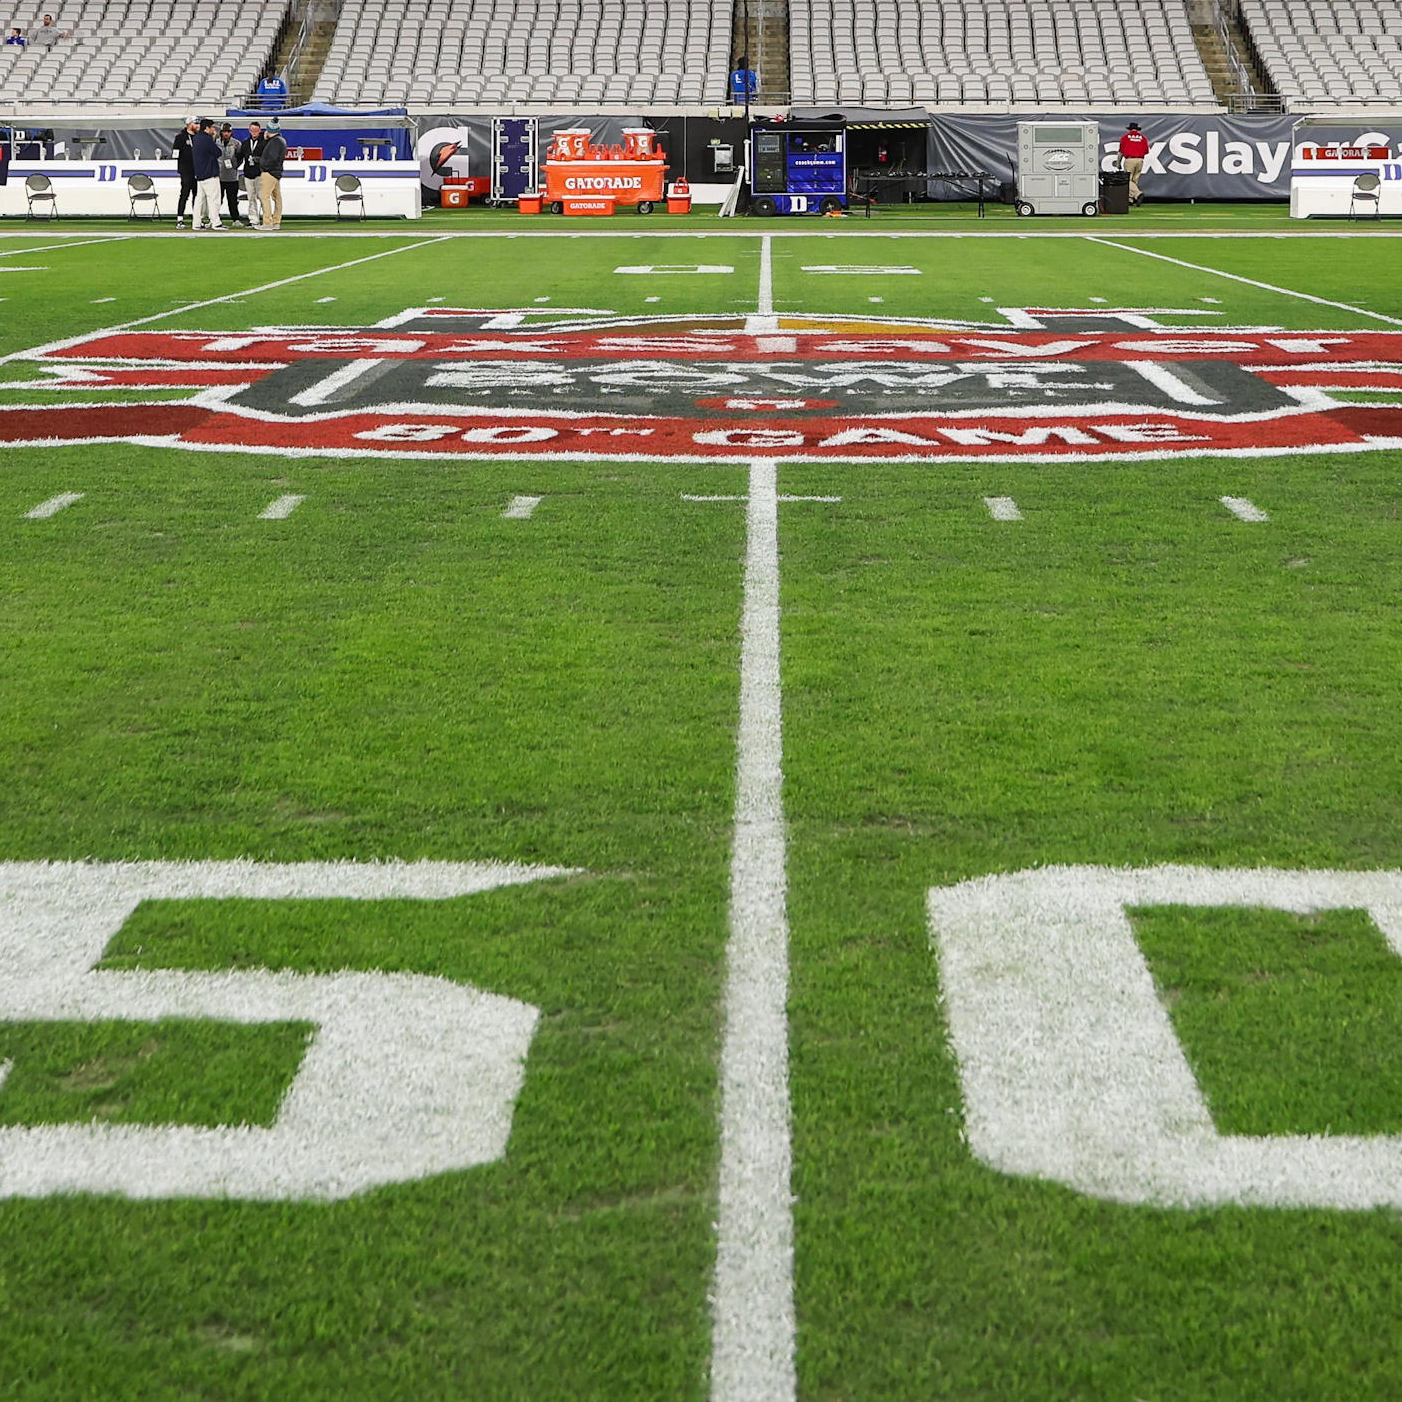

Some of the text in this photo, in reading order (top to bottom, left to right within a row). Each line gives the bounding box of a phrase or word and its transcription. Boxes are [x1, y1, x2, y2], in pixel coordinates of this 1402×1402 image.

[558, 137, 568, 148] G
[574, 137, 583, 149] G
[639, 135, 648, 148] G
[565, 177, 642, 190] GATORADE
[449, 192, 459, 205] G
[789, 196, 808, 212] D
[570, 201, 606, 210] GATORADE
[424, 372, 1115, 390] BOWL
[692, 425, 1214, 448] GAME
